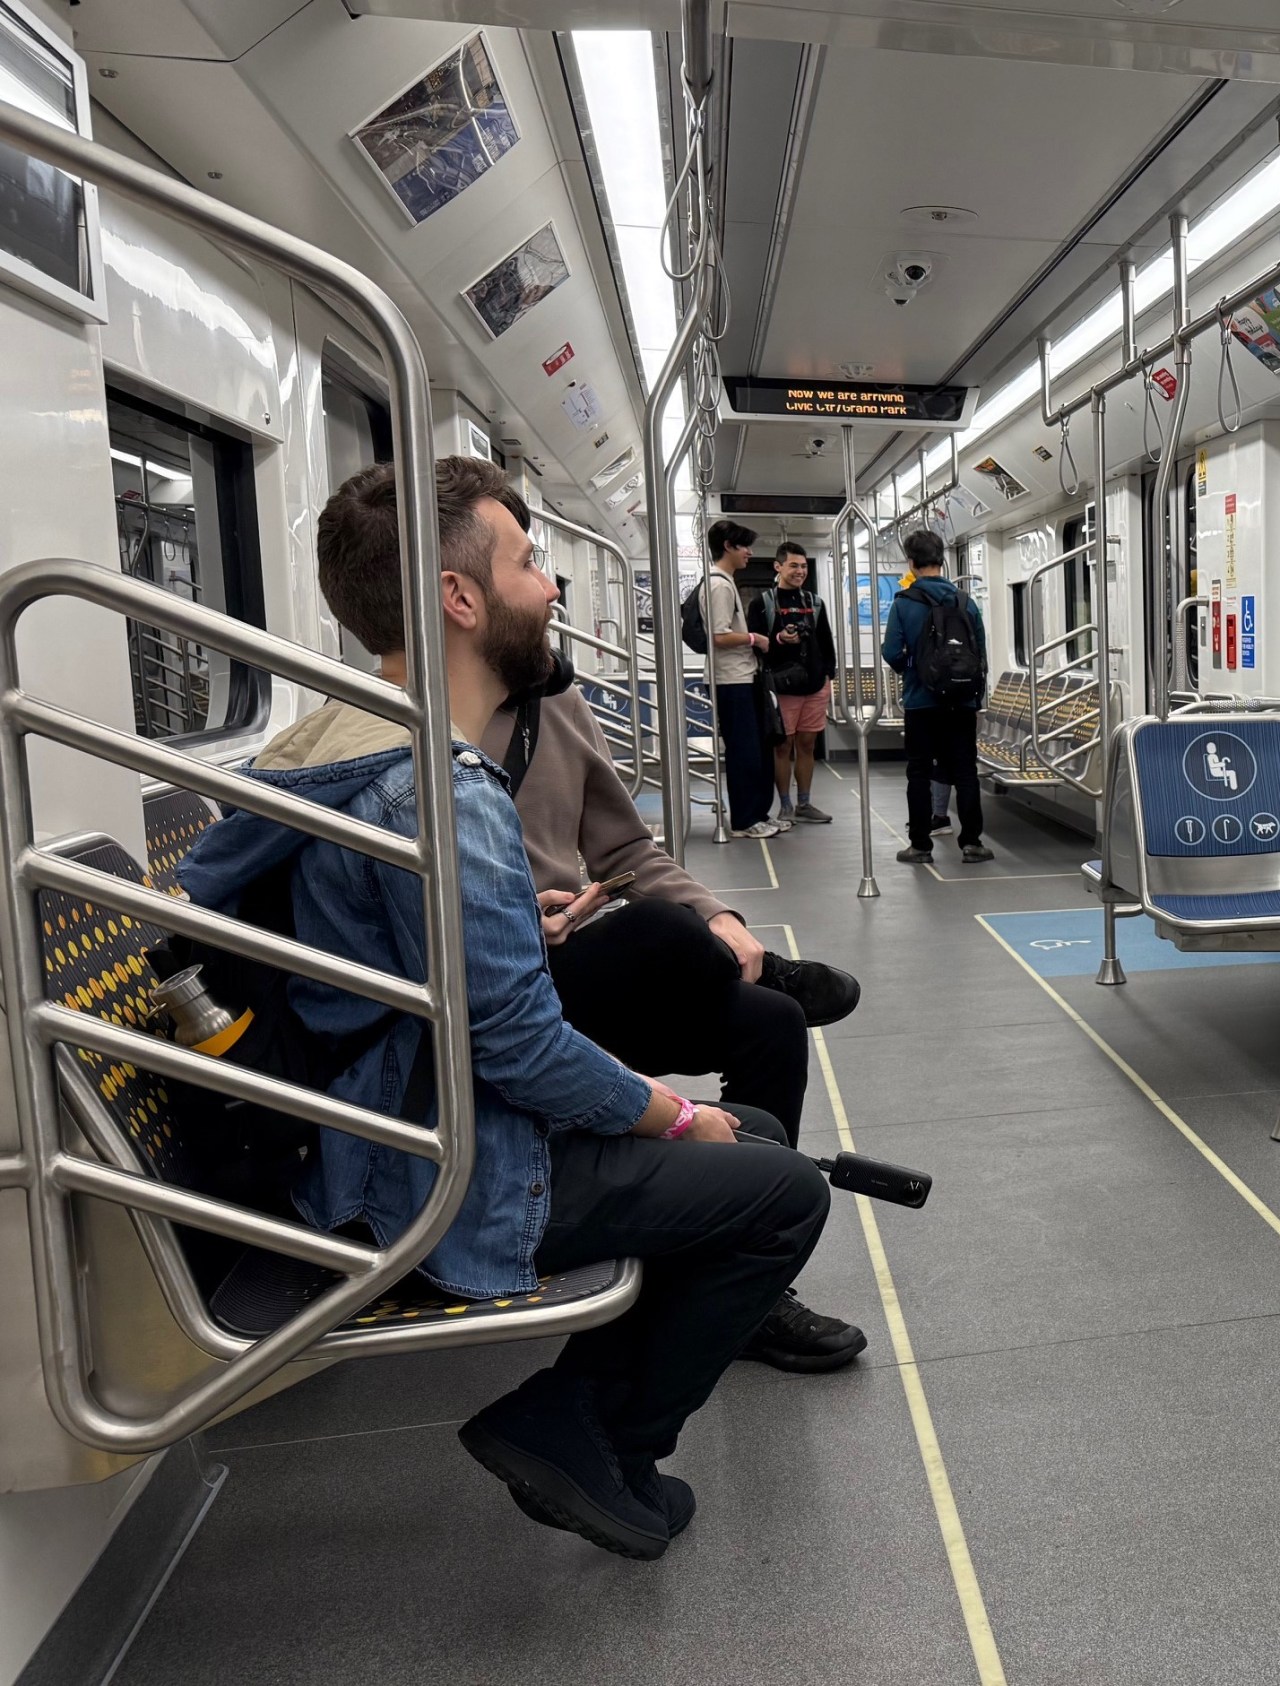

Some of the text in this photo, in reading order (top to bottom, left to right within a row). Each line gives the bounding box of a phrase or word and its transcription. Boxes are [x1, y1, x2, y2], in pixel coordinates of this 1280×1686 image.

[788, 390, 904, 402] Now we are arriving
[786, 402, 813, 411] Civic
[881, 406, 907, 415] Park
